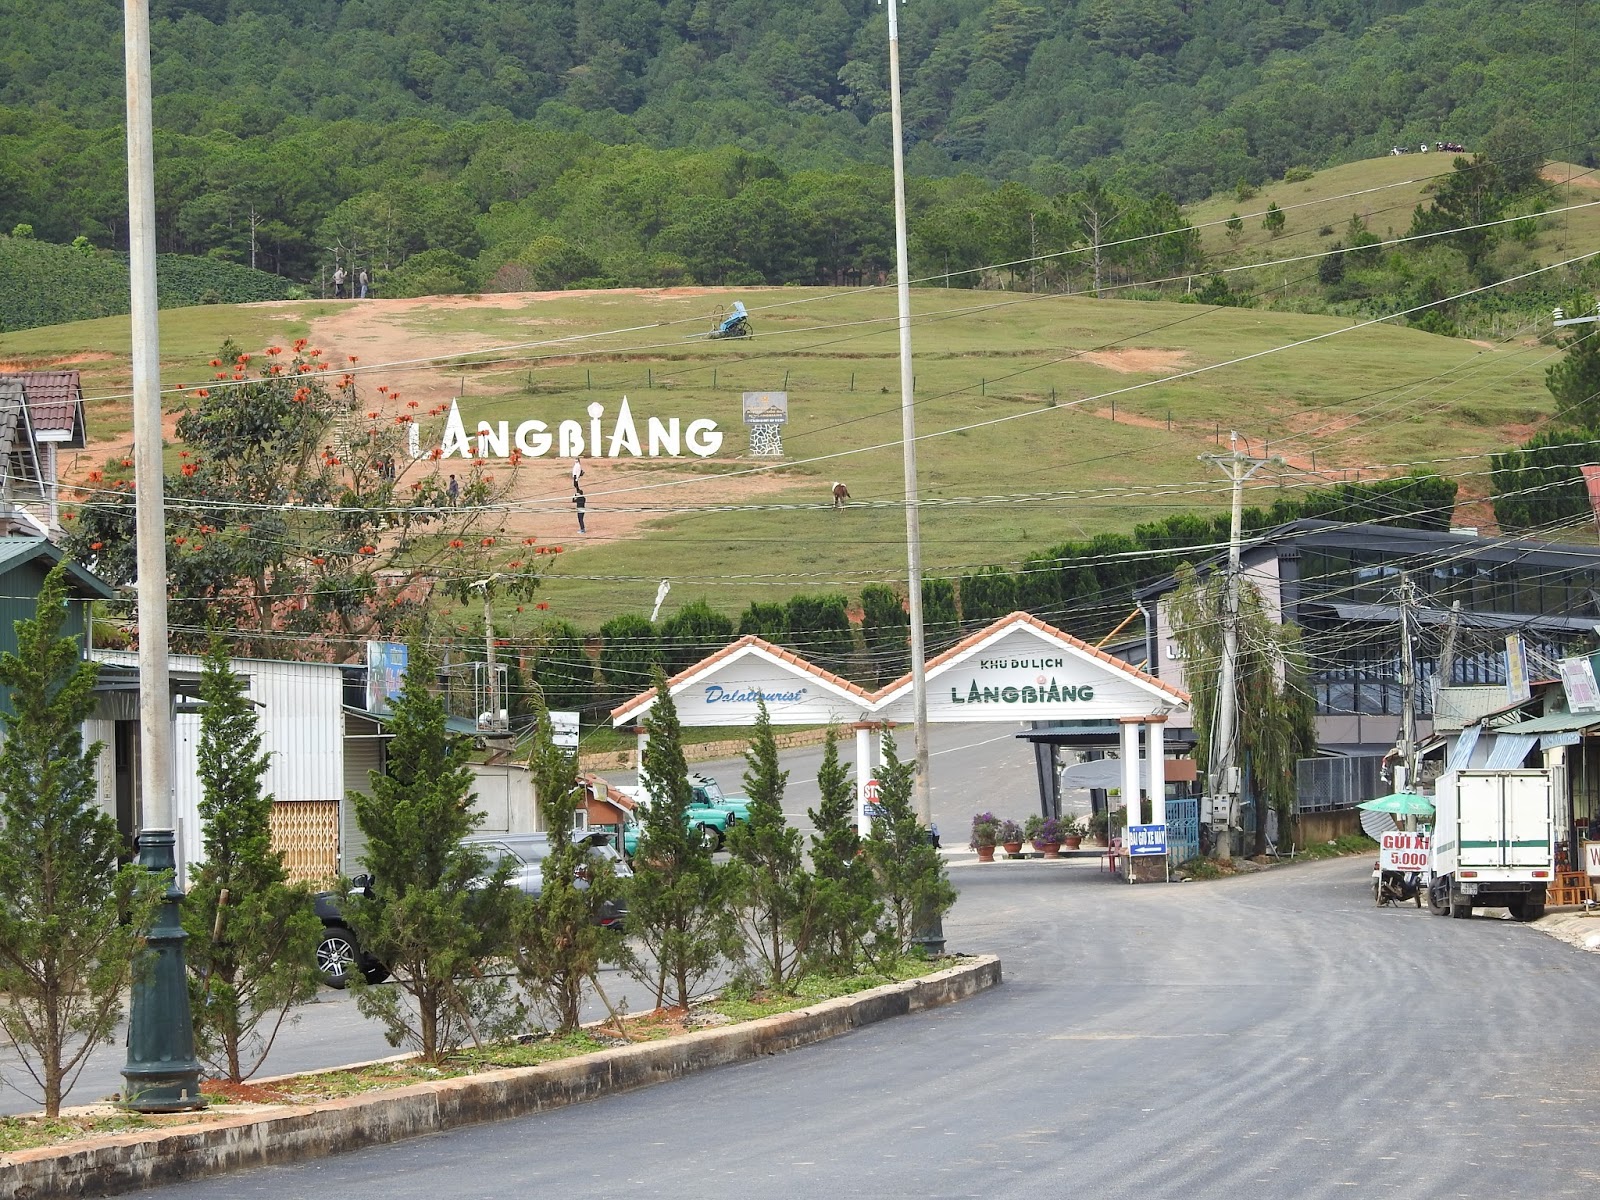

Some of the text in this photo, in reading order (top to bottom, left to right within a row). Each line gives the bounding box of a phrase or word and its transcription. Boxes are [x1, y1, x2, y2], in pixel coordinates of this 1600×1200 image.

[980, 658, 1063, 671] KHU DU LỊCH
[951, 675, 1094, 704] LANGBIANG
[1147, 831, 1154, 845] XE
[1391, 852, 1427, 866] 5.000
